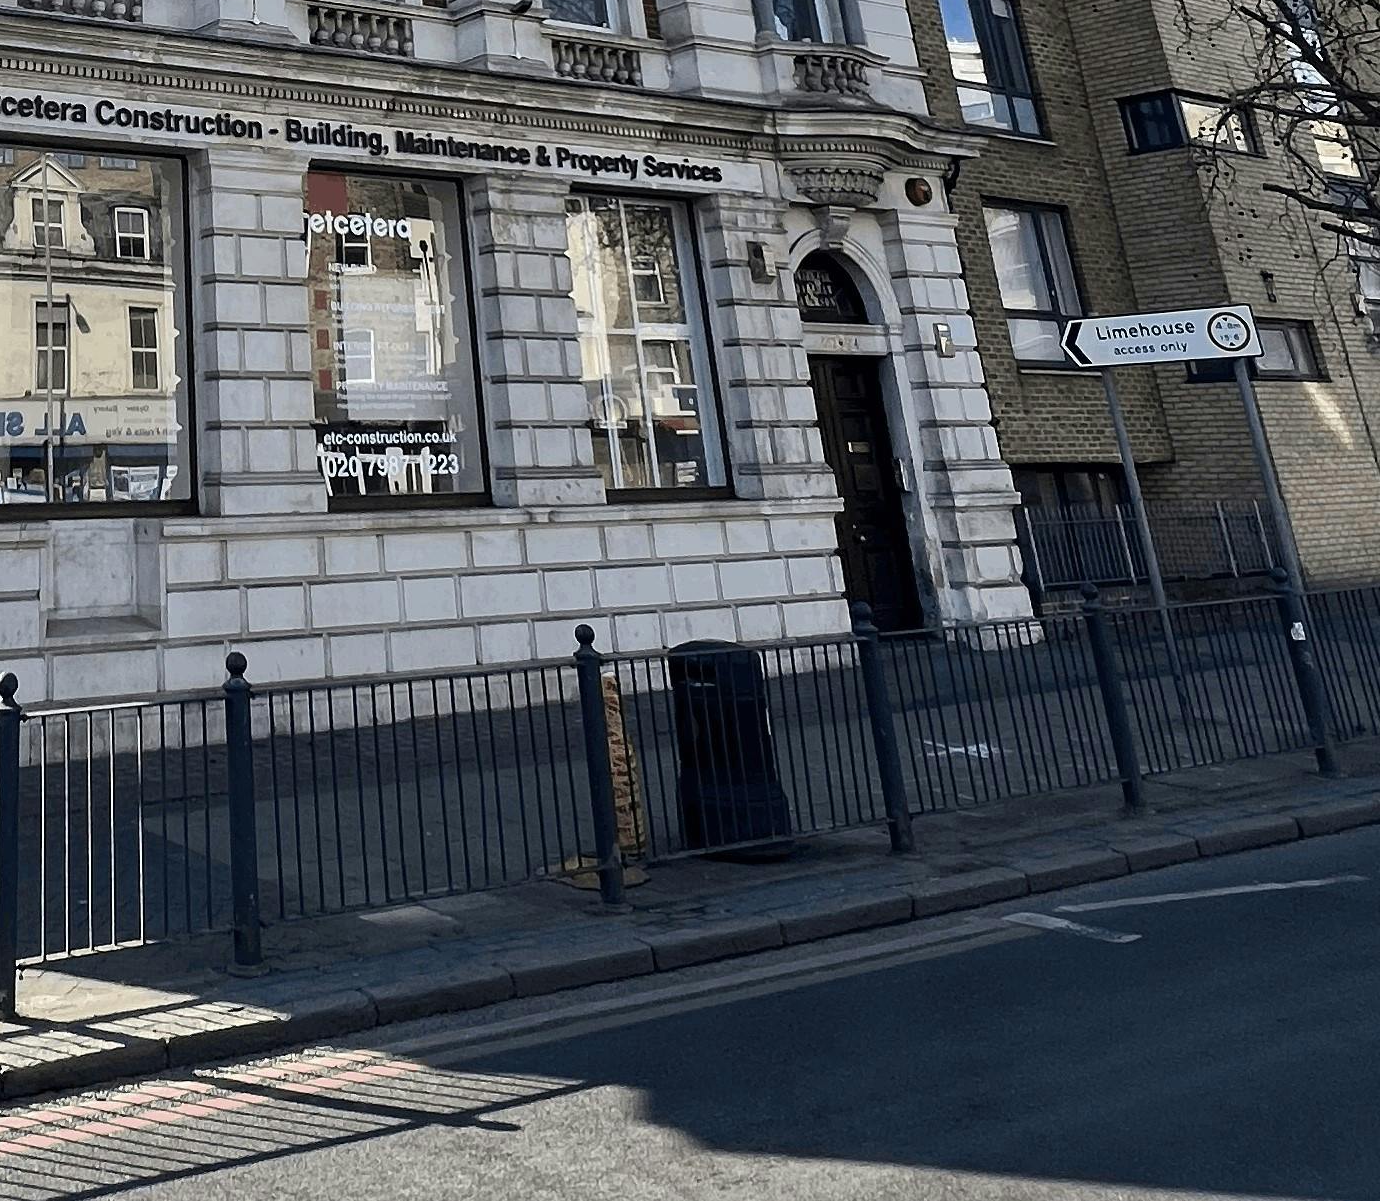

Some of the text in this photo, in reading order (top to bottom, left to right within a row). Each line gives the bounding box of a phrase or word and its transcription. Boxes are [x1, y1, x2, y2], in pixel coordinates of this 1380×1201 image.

[95, 99, 263, 140] Construction
[285, 119, 389, 156] Building,
[395, 130, 531, 166] Maintenance
[535, 145, 551, 167] &
[556, 147, 638, 179] Property
[643, 155, 723, 183] Services
[310, 210, 412, 239] etcetera
[1096, 320, 1195, 340] Limehouse
[1114, 341, 1188, 355] access only
[324, 430, 458, 445] etc-construction.co.uk
[326, 455, 358, 477] 020
[422, 454, 459, 475] 223
